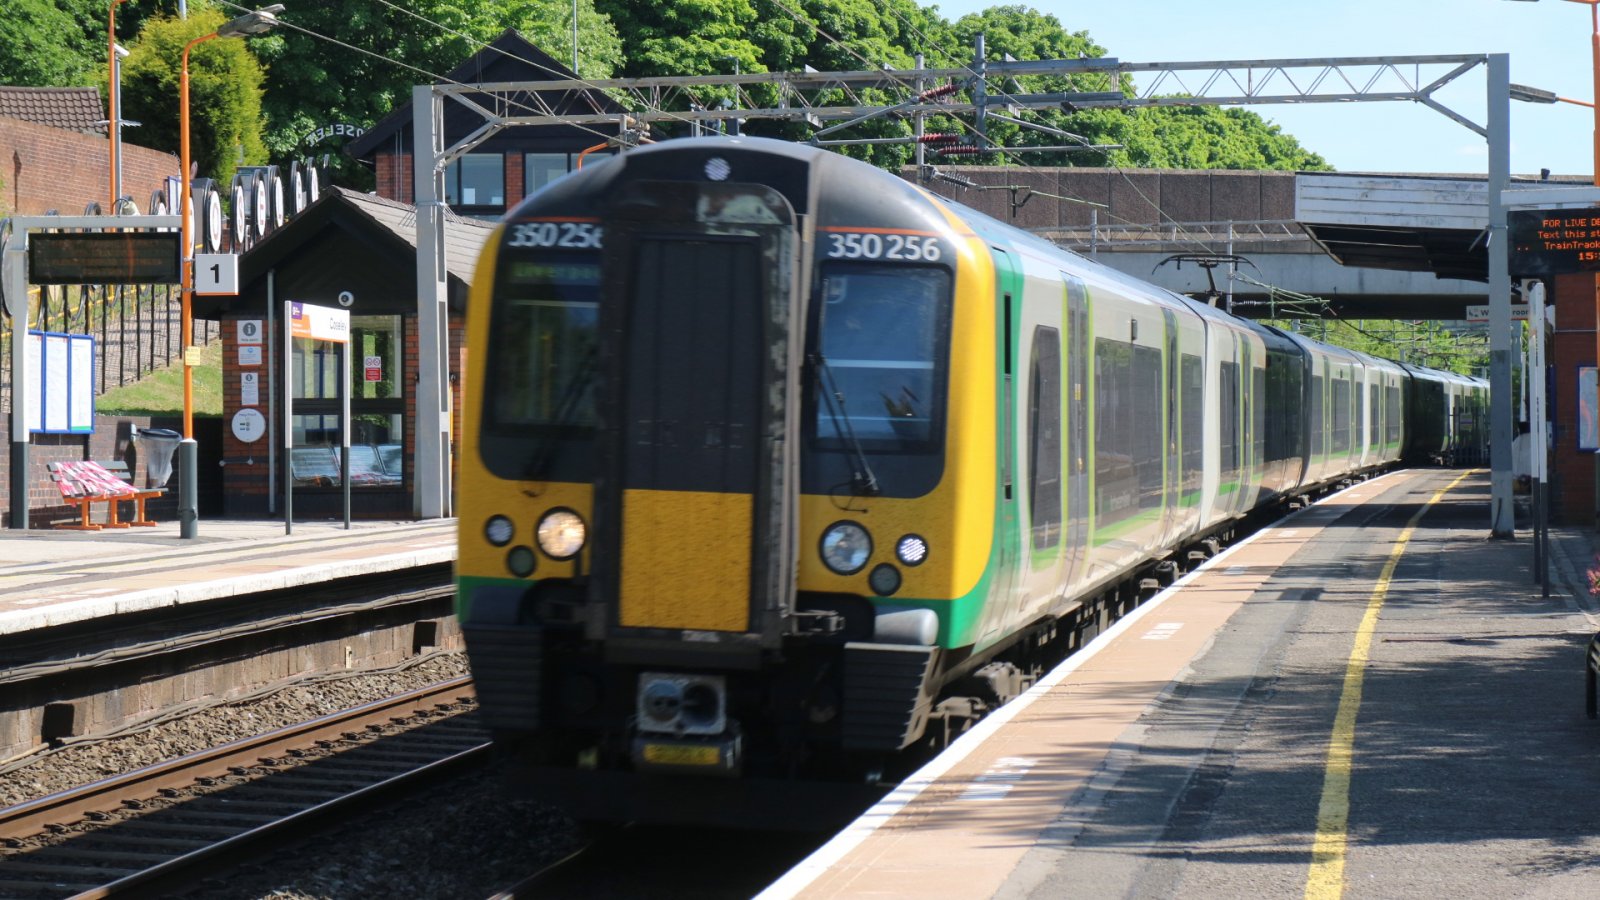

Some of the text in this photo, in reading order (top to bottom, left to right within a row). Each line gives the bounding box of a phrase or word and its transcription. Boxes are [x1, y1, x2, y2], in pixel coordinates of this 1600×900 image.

[1542, 219, 1561, 228] FOR
[1565, 218, 1587, 227] LIVE
[507, 222, 559, 247] 350
[1537, 230, 1560, 239] Text
[1565, 230, 1586, 238] this
[827, 233, 941, 262] 350 256
[1578, 251, 1600, 261] 15:
[209, 263, 220, 285] 1
